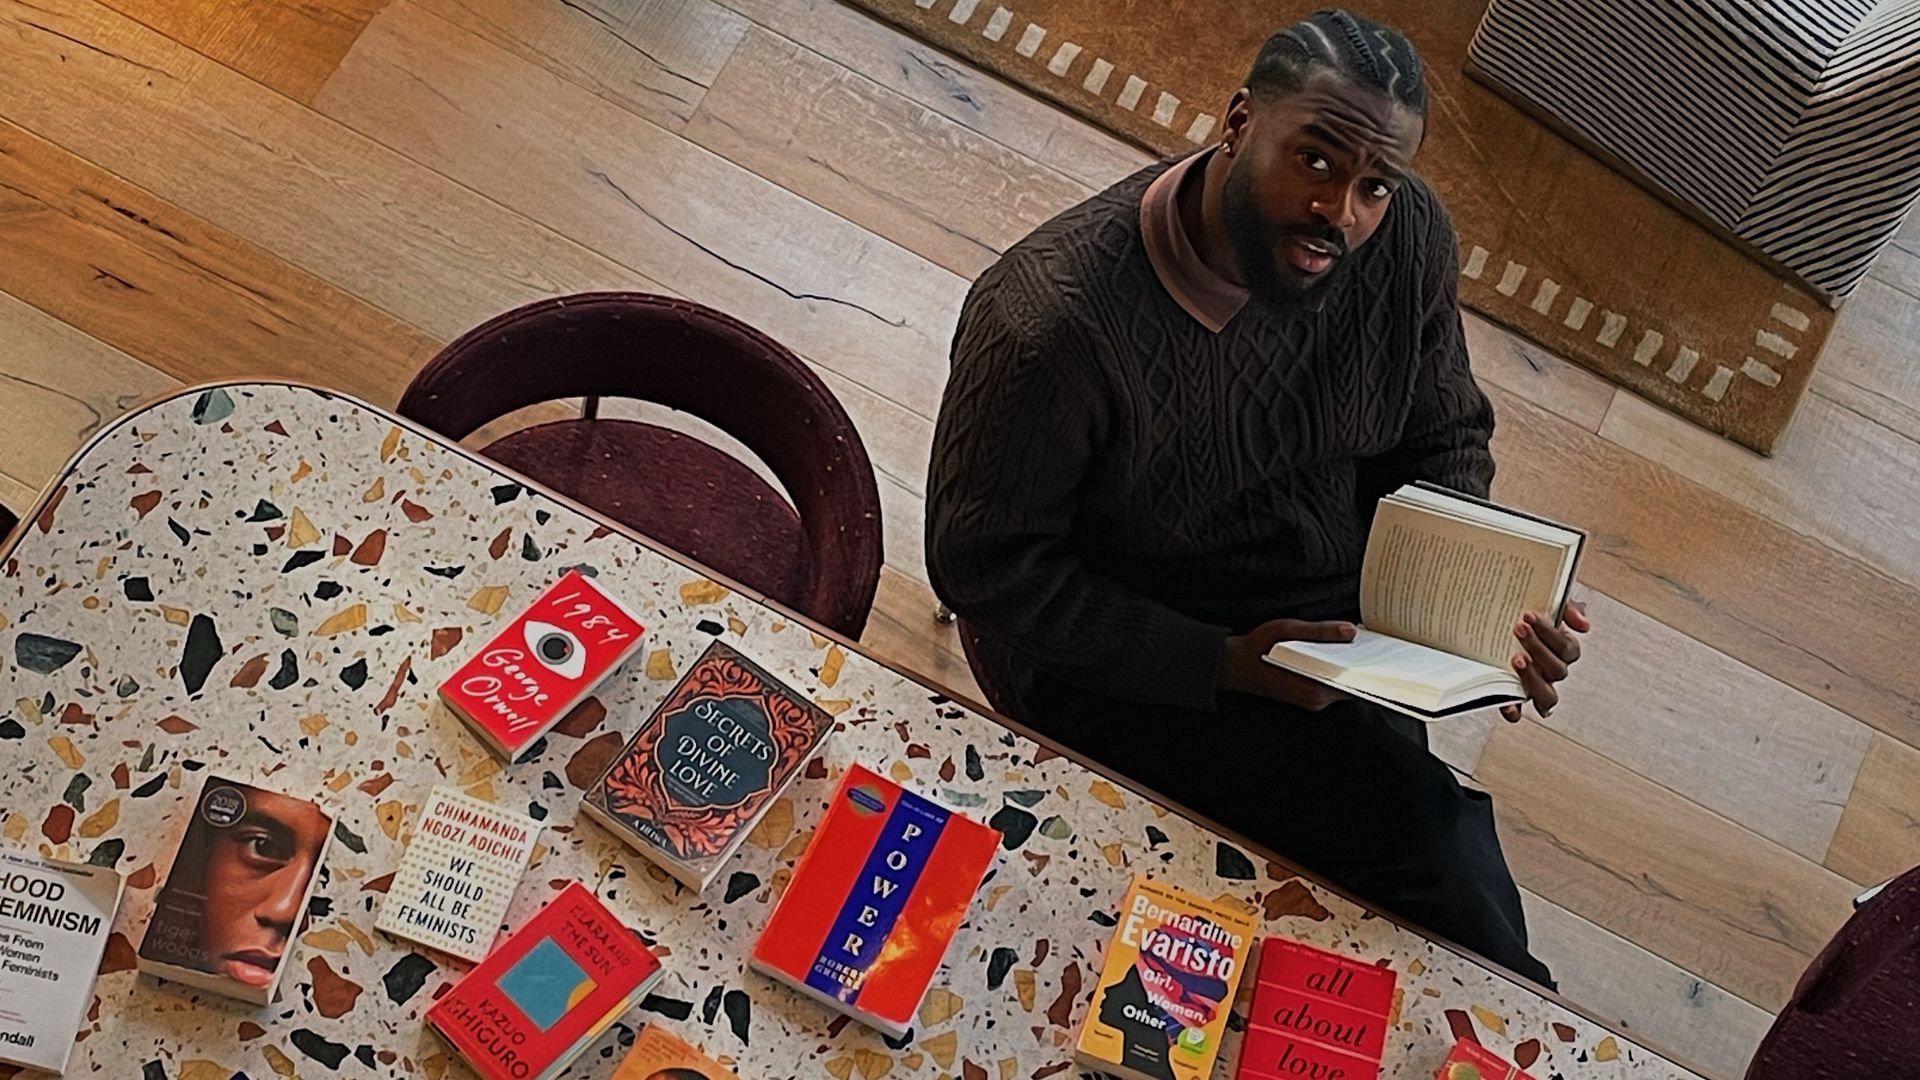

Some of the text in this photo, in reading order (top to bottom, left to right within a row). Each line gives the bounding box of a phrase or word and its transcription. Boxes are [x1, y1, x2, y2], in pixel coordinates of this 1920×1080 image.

[551, 592, 629, 645] 1984
[482, 648, 549, 706] George
[461, 676, 539, 732] Orwell
[694, 700, 773, 762] SECRETS
[706, 735, 736, 757] OF
[669, 760, 719, 799] LOVE
[677, 734, 741, 789] DIVINE
[421, 817, 525, 864] NGOZI ADICHIE
[434, 801, 528, 844] CHIMAMANDA
[423, 869, 484, 902] SHOULD
[449, 856, 476, 878] WE
[420, 890, 473, 920] ALL BE
[842, 823, 922, 957] POWER
[0, 896, 101, 936] EMINISM
[397, 904, 477, 944] FEMINISTS
[569, 905, 610, 946] KLARA
[1132, 894, 1242, 949] Bernardine
[12, 933, 45, 951] From
[562, 920, 616, 977] THE SUN
[1120, 914, 1236, 982] Evaristo
[1, 959, 60, 981] Feminists
[1306, 967, 1355, 997] all
[478, 997, 526, 1045] KAZUO
[1122, 1003, 1167, 1031] Other
[1273, 1003, 1368, 1048] about
[1276, 1043, 1346, 1080] love
